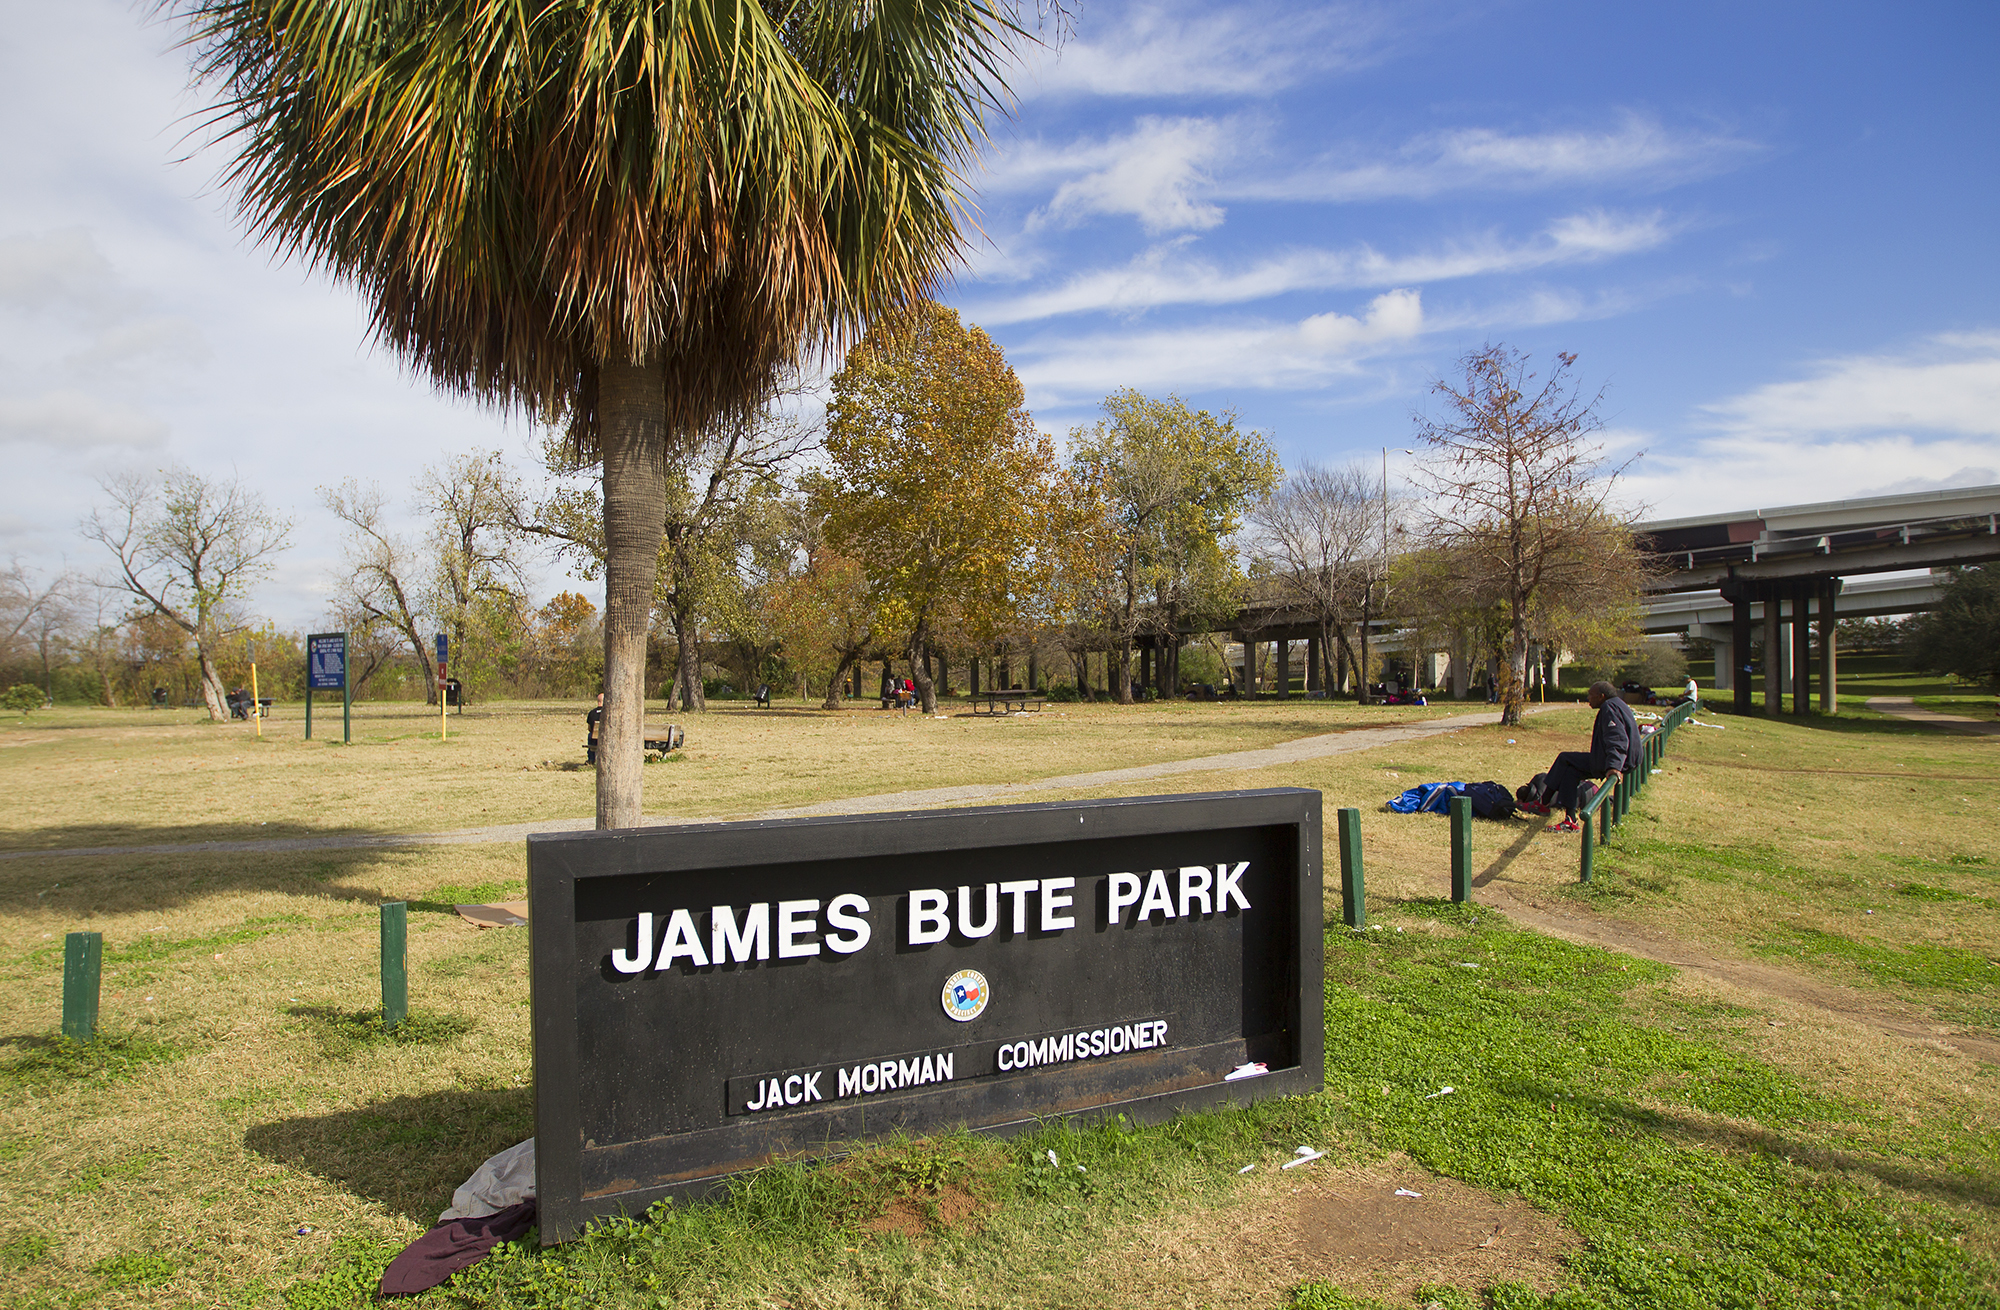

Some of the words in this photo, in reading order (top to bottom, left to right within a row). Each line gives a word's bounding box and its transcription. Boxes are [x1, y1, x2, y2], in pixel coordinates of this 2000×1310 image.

[611, 893, 872, 974] JAMES
[908, 876, 1076, 945] BUTE
[1108, 861, 1252, 925] PARK
[746, 1071, 823, 1111] JACK
[838, 1052, 954, 1097] MORMAN
[998, 1019, 1168, 1071] COMMISSIONER
